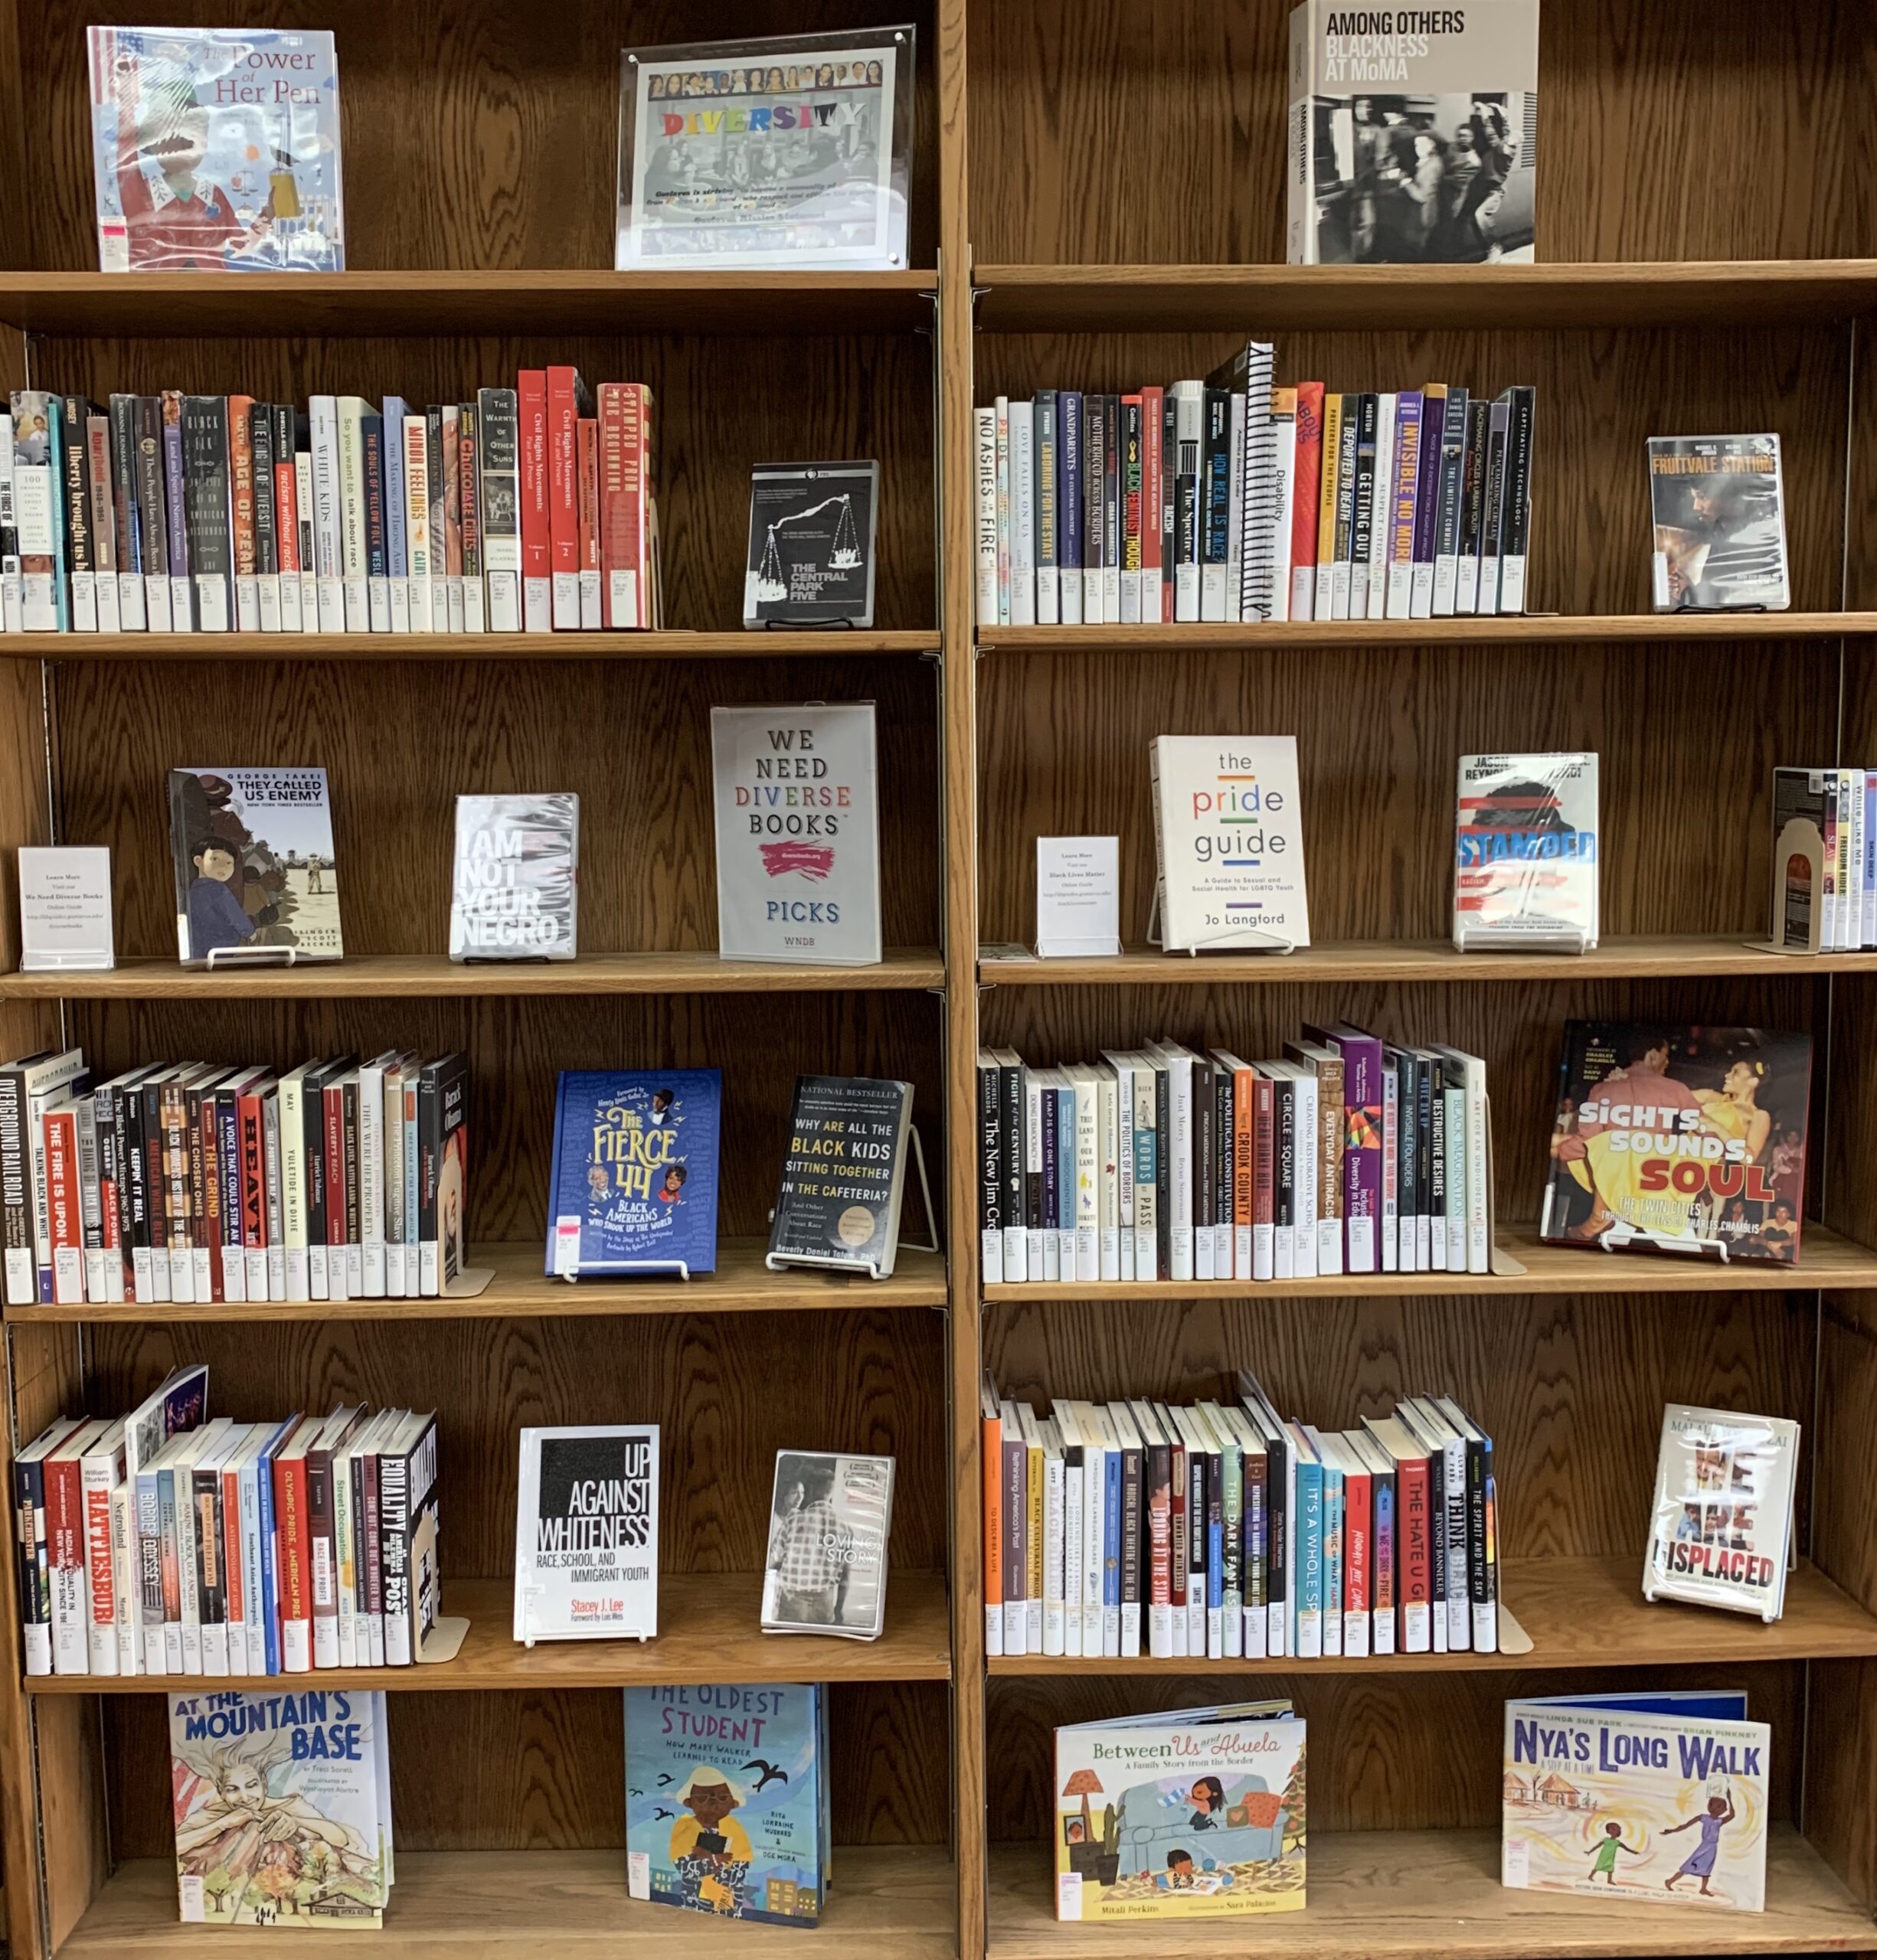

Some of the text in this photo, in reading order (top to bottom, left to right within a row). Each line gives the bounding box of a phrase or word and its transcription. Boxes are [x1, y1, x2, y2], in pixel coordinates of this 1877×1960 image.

[1326, 10, 1464, 35] AMONG OTHERS
[232, 45, 316, 70] Power
[1326, 34, 1428, 57] BLACKNESS
[243, 71, 255, 83] of
[1325, 58, 1408, 81] AT MoMA
[215, 80, 321, 104] Her Pen
[662, 102, 866, 136] DIVERSITY
[623, 388, 637, 449] STAMPED
[607, 426, 620, 492] BEGINNING
[979, 416, 993, 495] NO ASHES
[1399, 421, 1418, 495] INVISIBLE
[1653, 455, 1774, 475] FRUITVALE STATION
[318, 444, 330, 523] WHITE KIDS
[408, 426, 426, 521] MINOR FEELINGS
[1275, 470, 1286, 522] Disability
[236, 456, 253, 576] AGE OF FEAR
[1356, 472, 1372, 559] GETTING OUT
[791, 564, 816, 573] THE
[791, 573, 848, 582] CENTRAL
[790, 582, 823, 591] PARK
[790, 591, 816, 600] FIVE
[768, 730, 813, 751] WE
[757, 758, 828, 779] NEED
[1219, 753, 1252, 769] the
[238, 781, 322, 790] THEY CALLED
[244, 791, 322, 801] US ENEMY
[736, 787, 852, 807] DIVERSE
[1193, 784, 1283, 820] pride
[750, 814, 839, 835] BOOKS
[460, 830, 522, 858] I AM
[1195, 829, 1286, 861] guide
[1459, 832, 1595, 867] STAMPED
[1855, 850, 1862, 865] Me
[459, 858, 522, 887] NOT
[459, 887, 541, 916] YOUR
[767, 902, 839, 923] PICKS
[461, 916, 559, 946] NEGRO
[1205, 914, 1285, 926] Jo Langford
[785, 937, 815, 946] WNDB
[796, 1119, 892, 1135] WHY ARE ALL THE
[594, 1123, 678, 1170] FIERCE
[791, 1137, 891, 1160] BLACK KIDS
[1281, 1093, 1291, 1188] CIRCLE SQUARE
[1610, 1131, 1753, 1164] SOUNDS,
[786, 1161, 889, 1179] SITTING TOGETHER
[1139, 1135, 1151, 1179] WORDS
[48, 1122, 67, 1237] THE FIRE IS UPON
[616, 1164, 654, 1200] 44
[1237, 1132, 1249, 1216] CROOK COUNTY
[1640, 1159, 1775, 1201] SOUL
[782, 1182, 888, 1201] IN THE CAFETERIA?
[606, 1208, 658, 1223] AMERICANS
[618, 1200, 648, 1213] BLACK
[604, 1221, 625, 1233] SHOOK
[626, 1223, 635, 1233] UP
[650, 1217, 672, 1230] WORLD
[626, 1444, 650, 1478] UP
[381, 1458, 406, 1531] EQUALITY
[568, 1479, 649, 1516] AGAINST
[114, 1501, 126, 1549] Negroland
[538, 1515, 649, 1551] WHITENESS
[1410, 1481, 1424, 1579] THE HATE U
[1448, 1493, 1464, 1550] THINK
[816, 1534, 878, 1550] LOVING
[1306, 1488, 1318, 1588] IT'S A WHOLE
[537, 1553, 615, 1569] RACE, SCHOOL, AND
[827, 1549, 876, 1564] STORY
[571, 1568, 649, 1583] IMMIGRANT YOUTH
[318, 1579, 326, 1600] PROFIT
[571, 1599, 623, 1613] Stacey J. Lee
[175, 1692, 244, 1715] AT THE
[651, 1685, 784, 1716] THE OLDEST
[185, 1690, 351, 1740] MOUNTAIN'S
[662, 1707, 767, 1748] STUDENT
[291, 1724, 362, 1760] BASE
[666, 1740, 750, 1757] HOW MARY WALKER
[1093, 1732, 1280, 1759] Between Us and Abuela
[673, 1752, 707, 1762] LEARNED
[722, 1757, 743, 1766] READ
